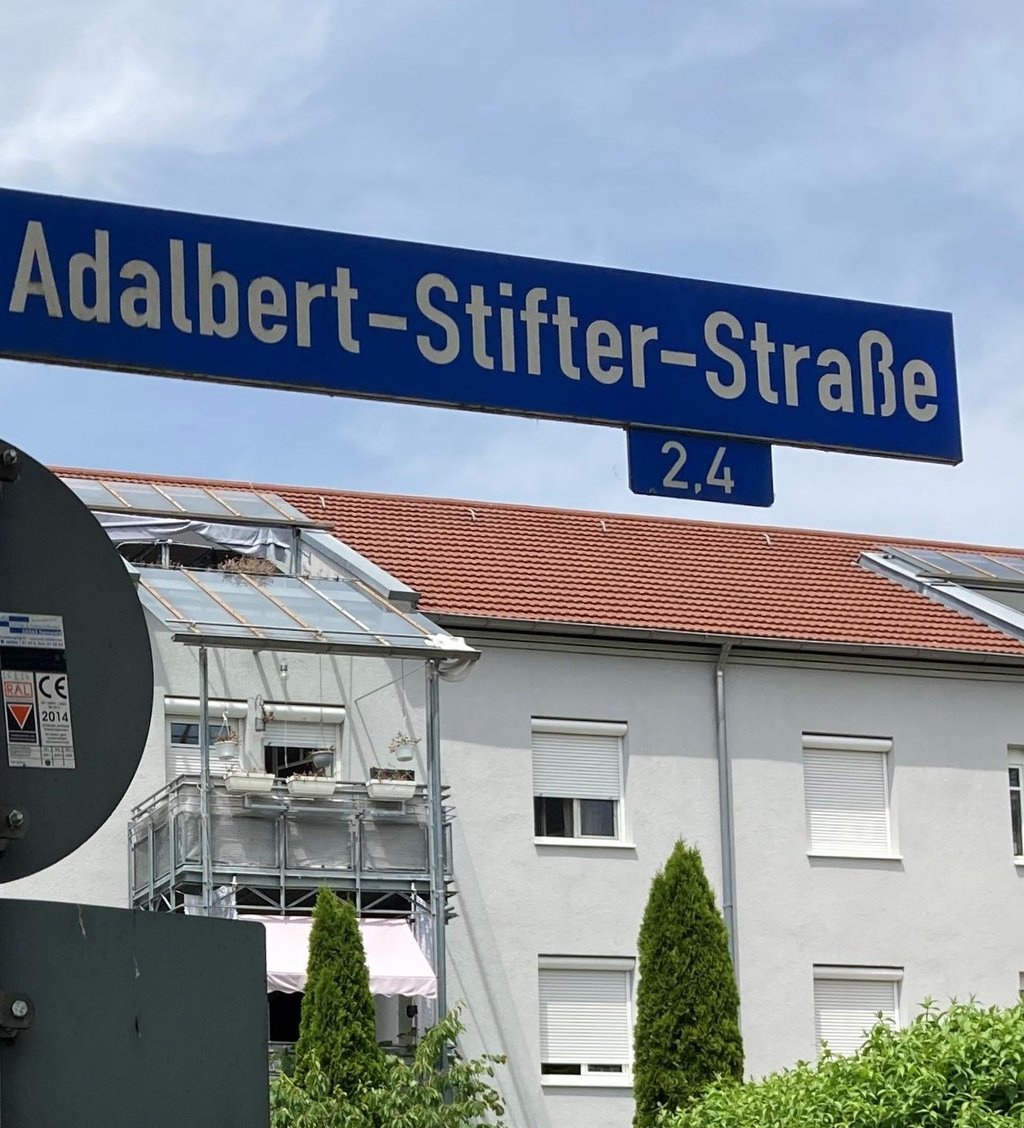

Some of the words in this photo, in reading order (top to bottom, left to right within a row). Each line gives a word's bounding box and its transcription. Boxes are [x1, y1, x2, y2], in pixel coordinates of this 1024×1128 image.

[9, 221, 939, 422] Adalbert-Stifter-Straße
[661, 440, 735, 495] 2,4
[6, 683, 31, 696] RAL
[39, 675, 67, 699] CE
[42, 711, 68, 722] 2014
